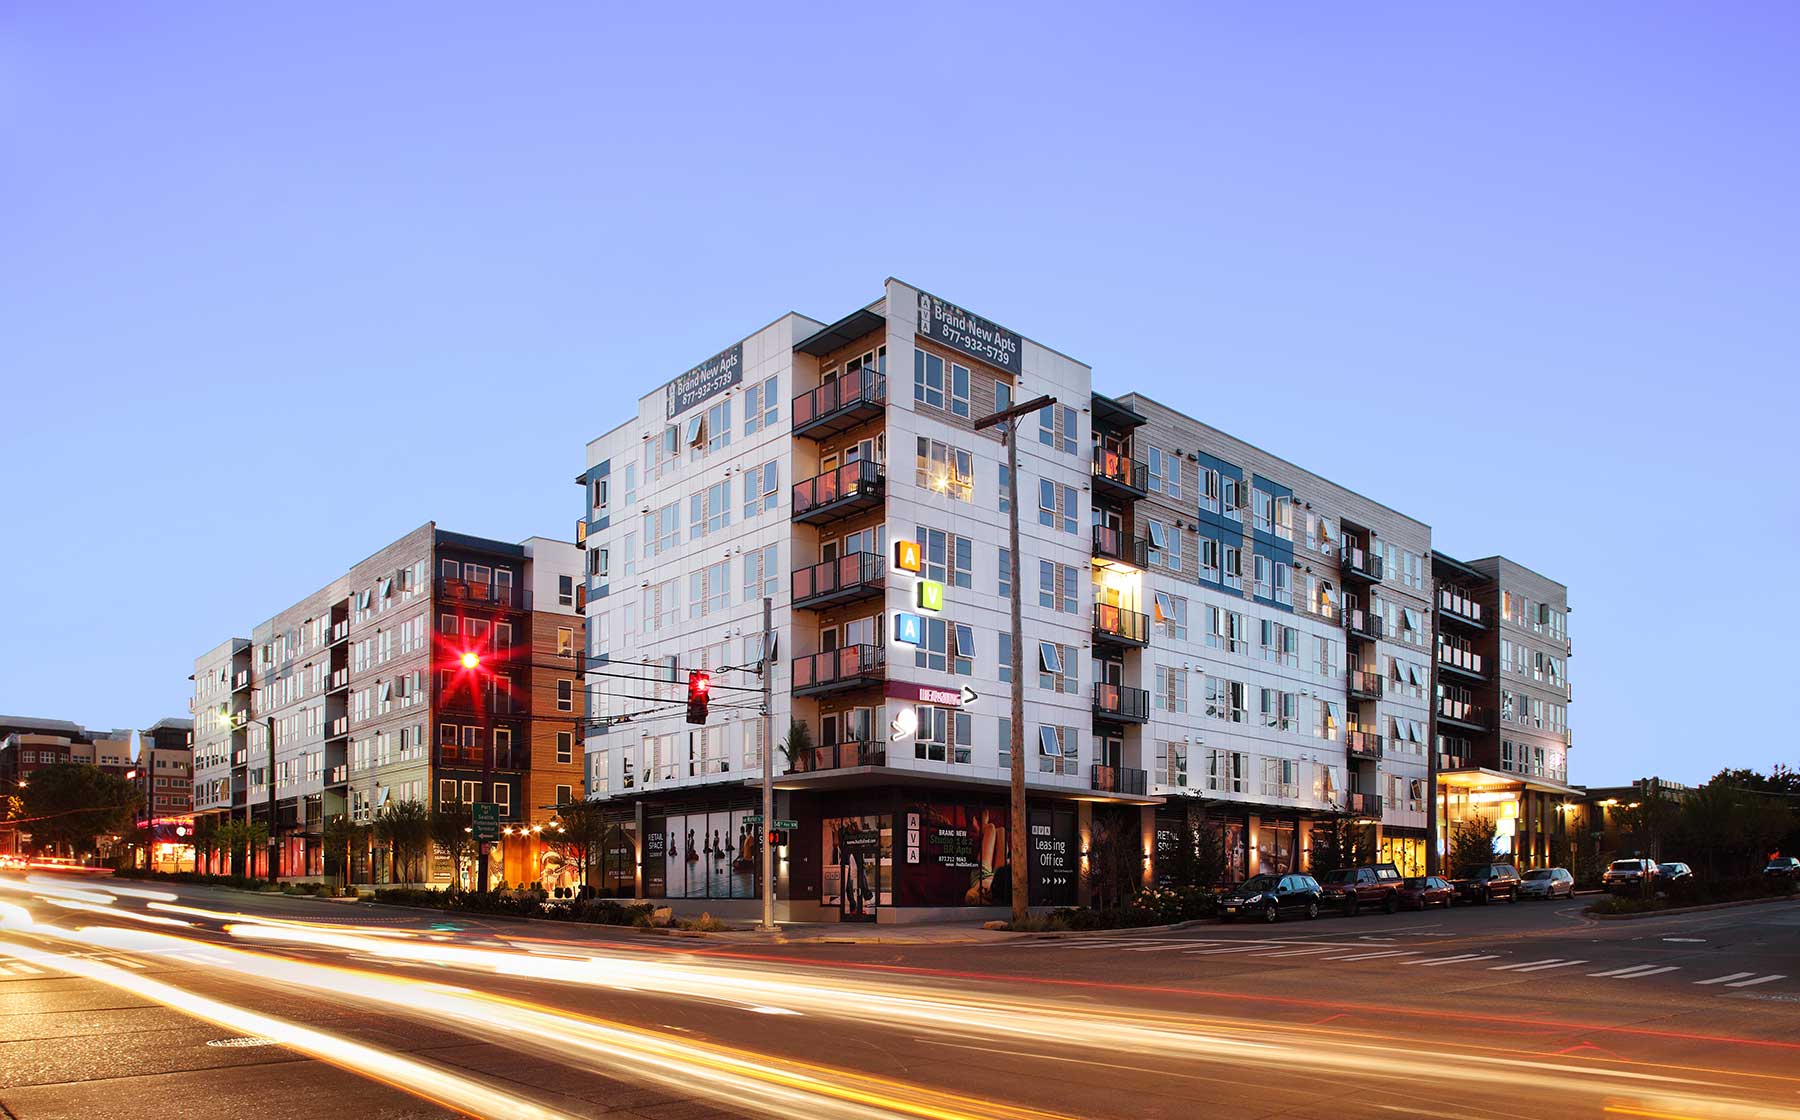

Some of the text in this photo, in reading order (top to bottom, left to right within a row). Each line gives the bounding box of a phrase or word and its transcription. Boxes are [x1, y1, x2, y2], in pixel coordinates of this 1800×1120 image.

[935, 305, 1016, 353] Brand New Apts
[942, 324, 1009, 365] 877-932-5739
[677, 354, 738, 396] Brand New Apts
[682, 371, 732, 405] 877-932-5739
[648, 841, 663, 850] SPACE
[1035, 837, 1066, 854] Leasing
[1040, 853, 1064, 866] Office
